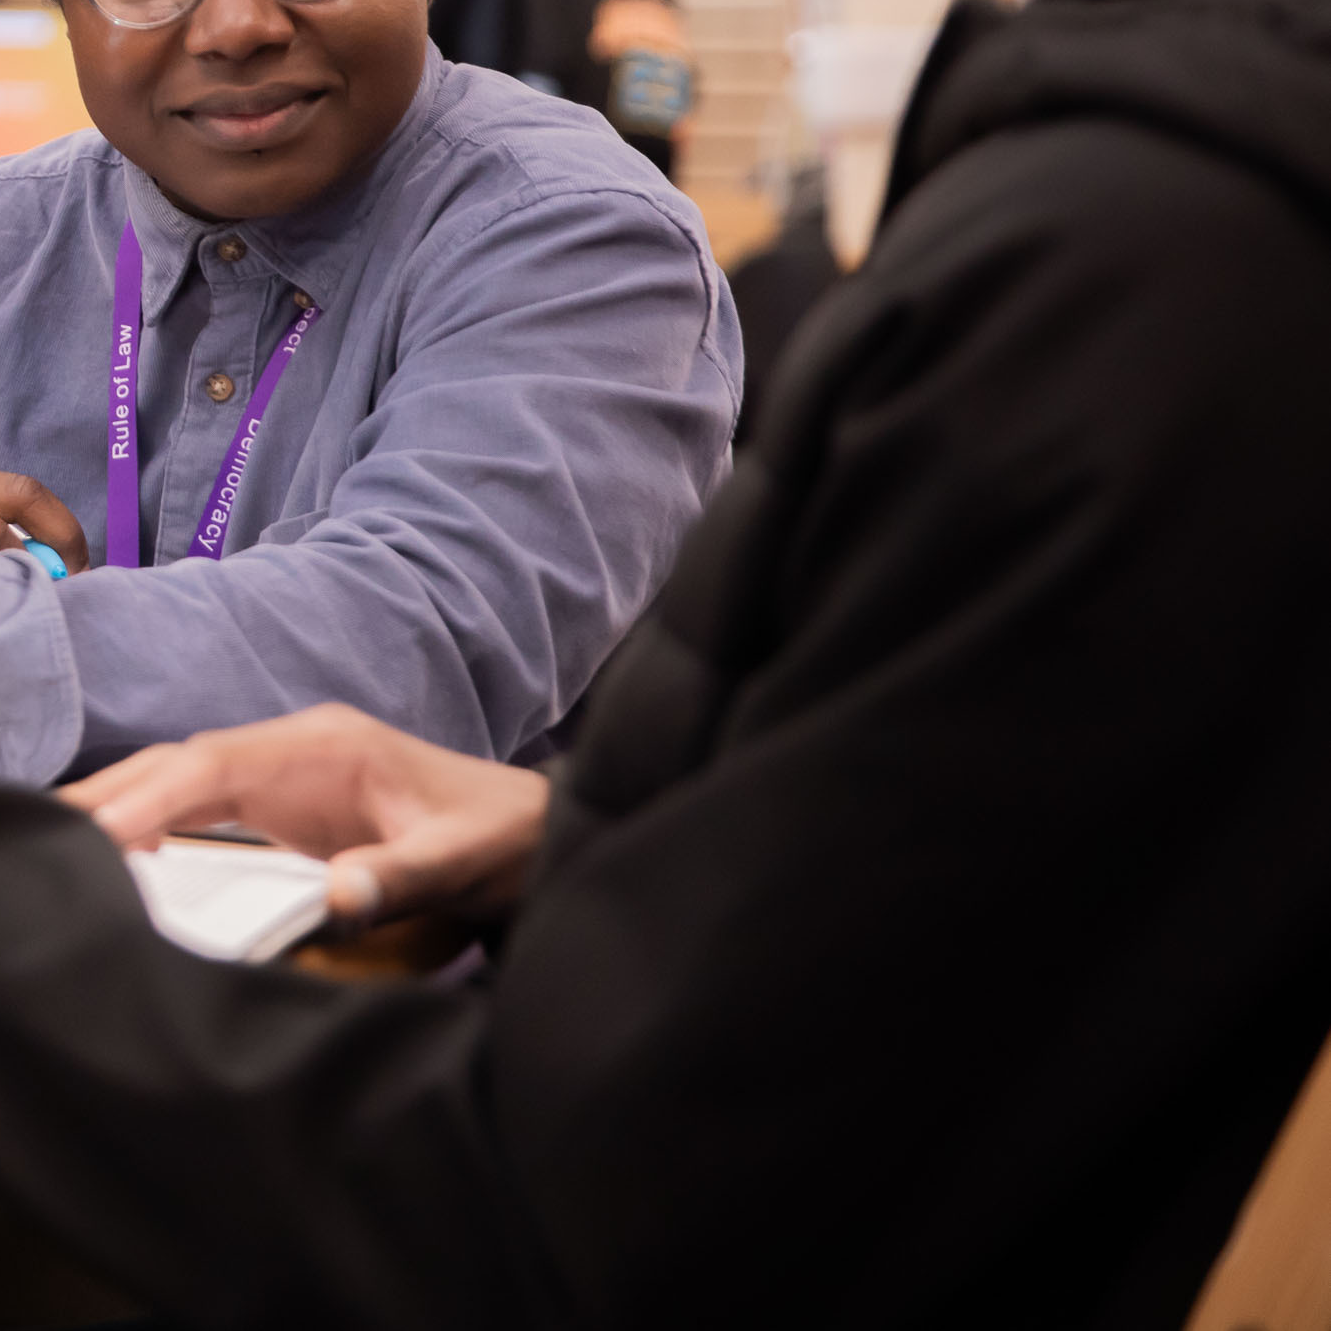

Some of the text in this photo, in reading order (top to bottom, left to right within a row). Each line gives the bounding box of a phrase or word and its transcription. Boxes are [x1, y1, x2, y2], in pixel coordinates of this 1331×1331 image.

[111, 324, 133, 460] Rule of Law
